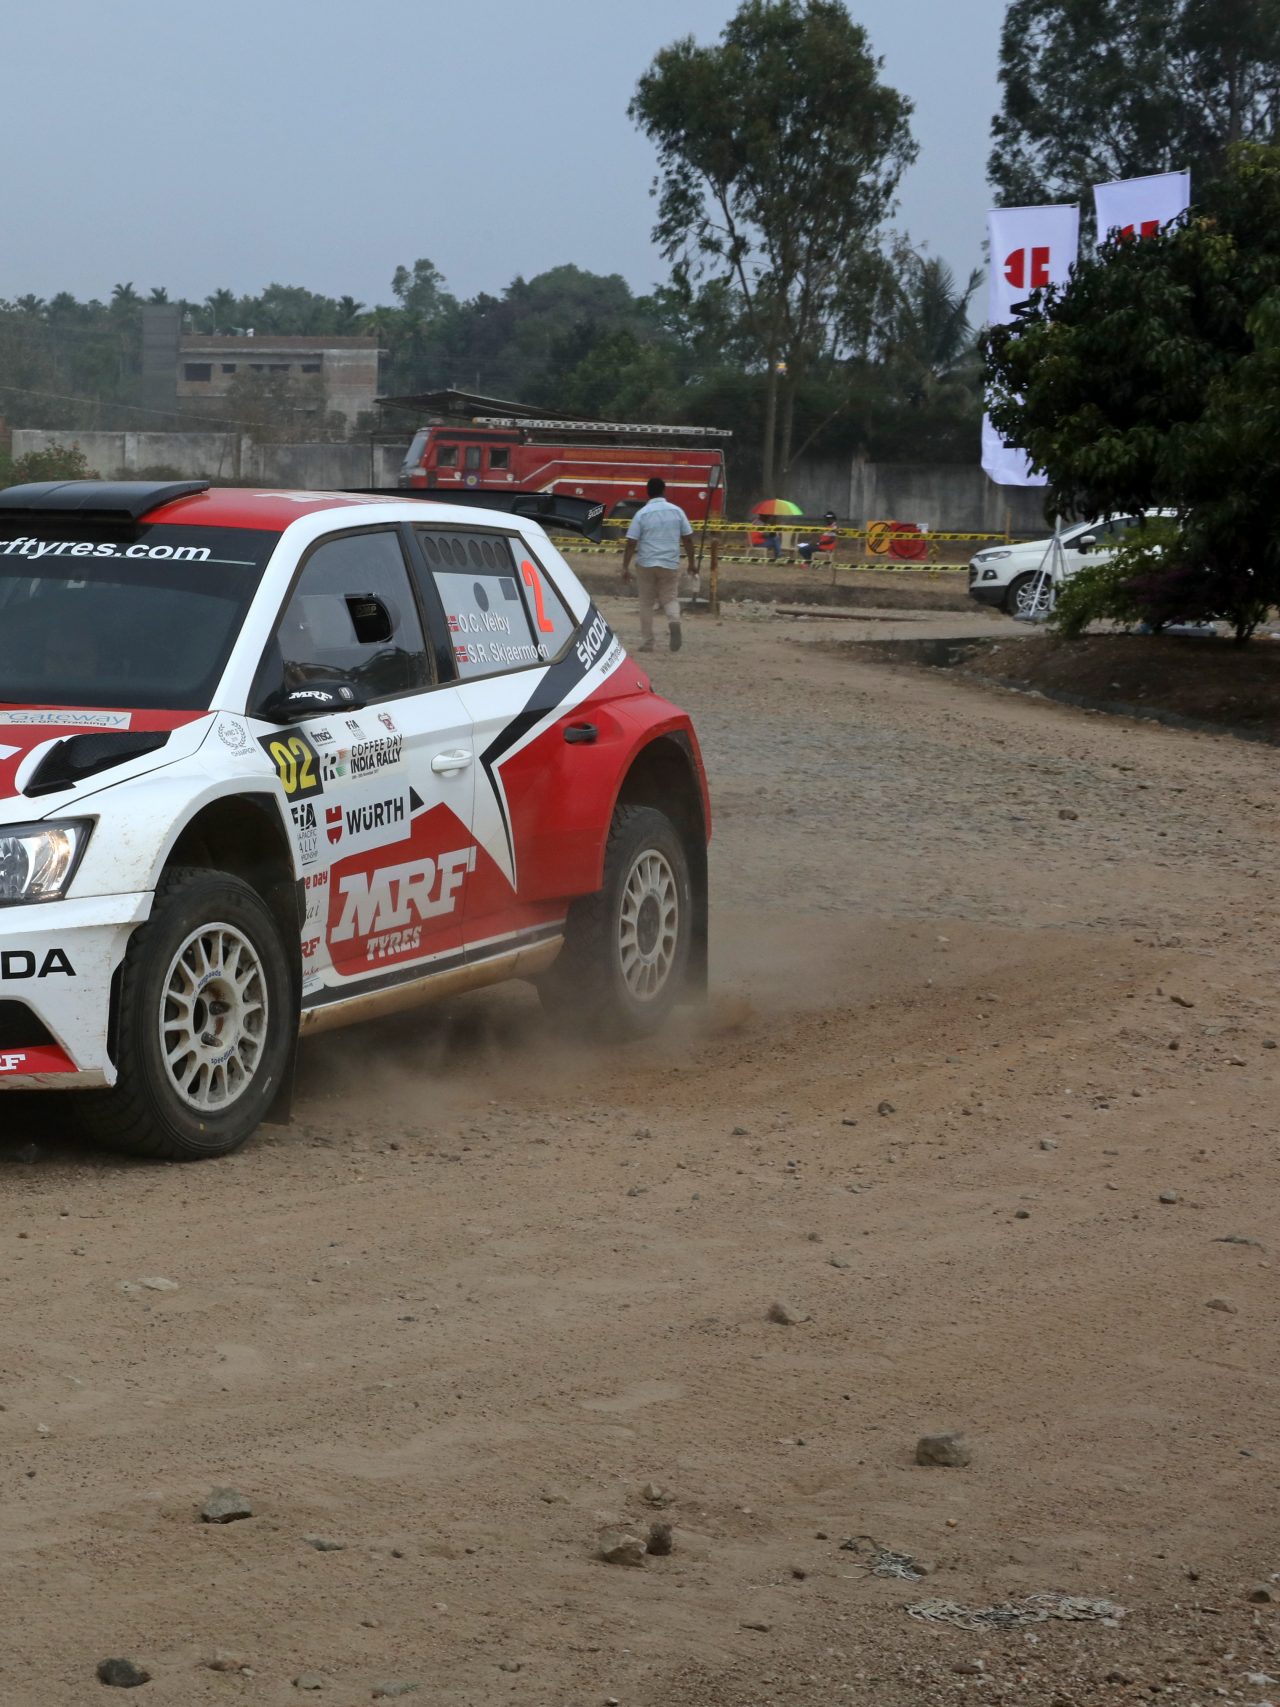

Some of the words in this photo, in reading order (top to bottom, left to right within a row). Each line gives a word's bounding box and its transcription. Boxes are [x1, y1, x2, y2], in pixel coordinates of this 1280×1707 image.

[521, 559, 554, 633] 2
[457, 614, 483, 634] O.C.
[482, 612, 510, 634] Veiby
[467, 644, 491, 664] S.R.
[576, 610, 609, 671] ŠKODA
[288, 690, 333, 701] MRF
[350, 754, 376, 774] INDIA
[376, 747, 402, 767] RALLY
[351, 738, 385, 758] COFFEE
[387, 734, 403, 748] DAY
[270, 736, 317, 794] 02
[346, 796, 404, 835] WÜRTH
[298, 838, 317, 854] ALLY
[330, 845, 477, 944] MRF
[367, 925, 423, 961] TYRES
